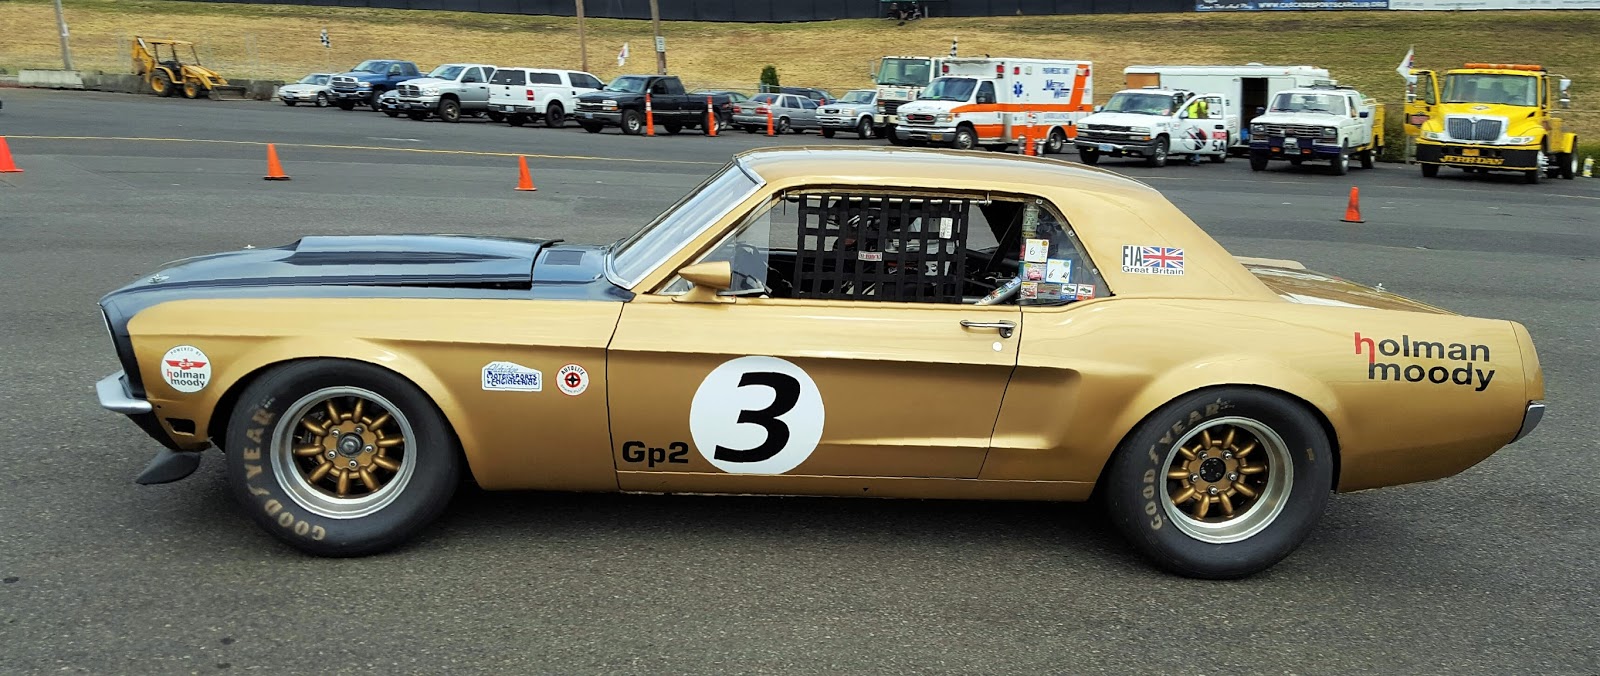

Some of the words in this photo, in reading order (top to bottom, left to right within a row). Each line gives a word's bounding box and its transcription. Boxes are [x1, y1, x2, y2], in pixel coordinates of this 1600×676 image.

[1029, 247, 1036, 256] 6
[1122, 245, 1143, 267] FIA
[1122, 265, 1150, 274] Great
[1152, 267, 1184, 275] Britain
[1354, 332, 1490, 363] holman
[167, 369, 206, 380] holman
[560, 365, 586, 376] AUTOLITE
[490, 378, 538, 387] ENGINEERING
[1368, 362, 1496, 392] moody
[170, 378, 206, 388] moody
[714, 371, 801, 463] 3
[622, 441, 689, 468] Gp2
